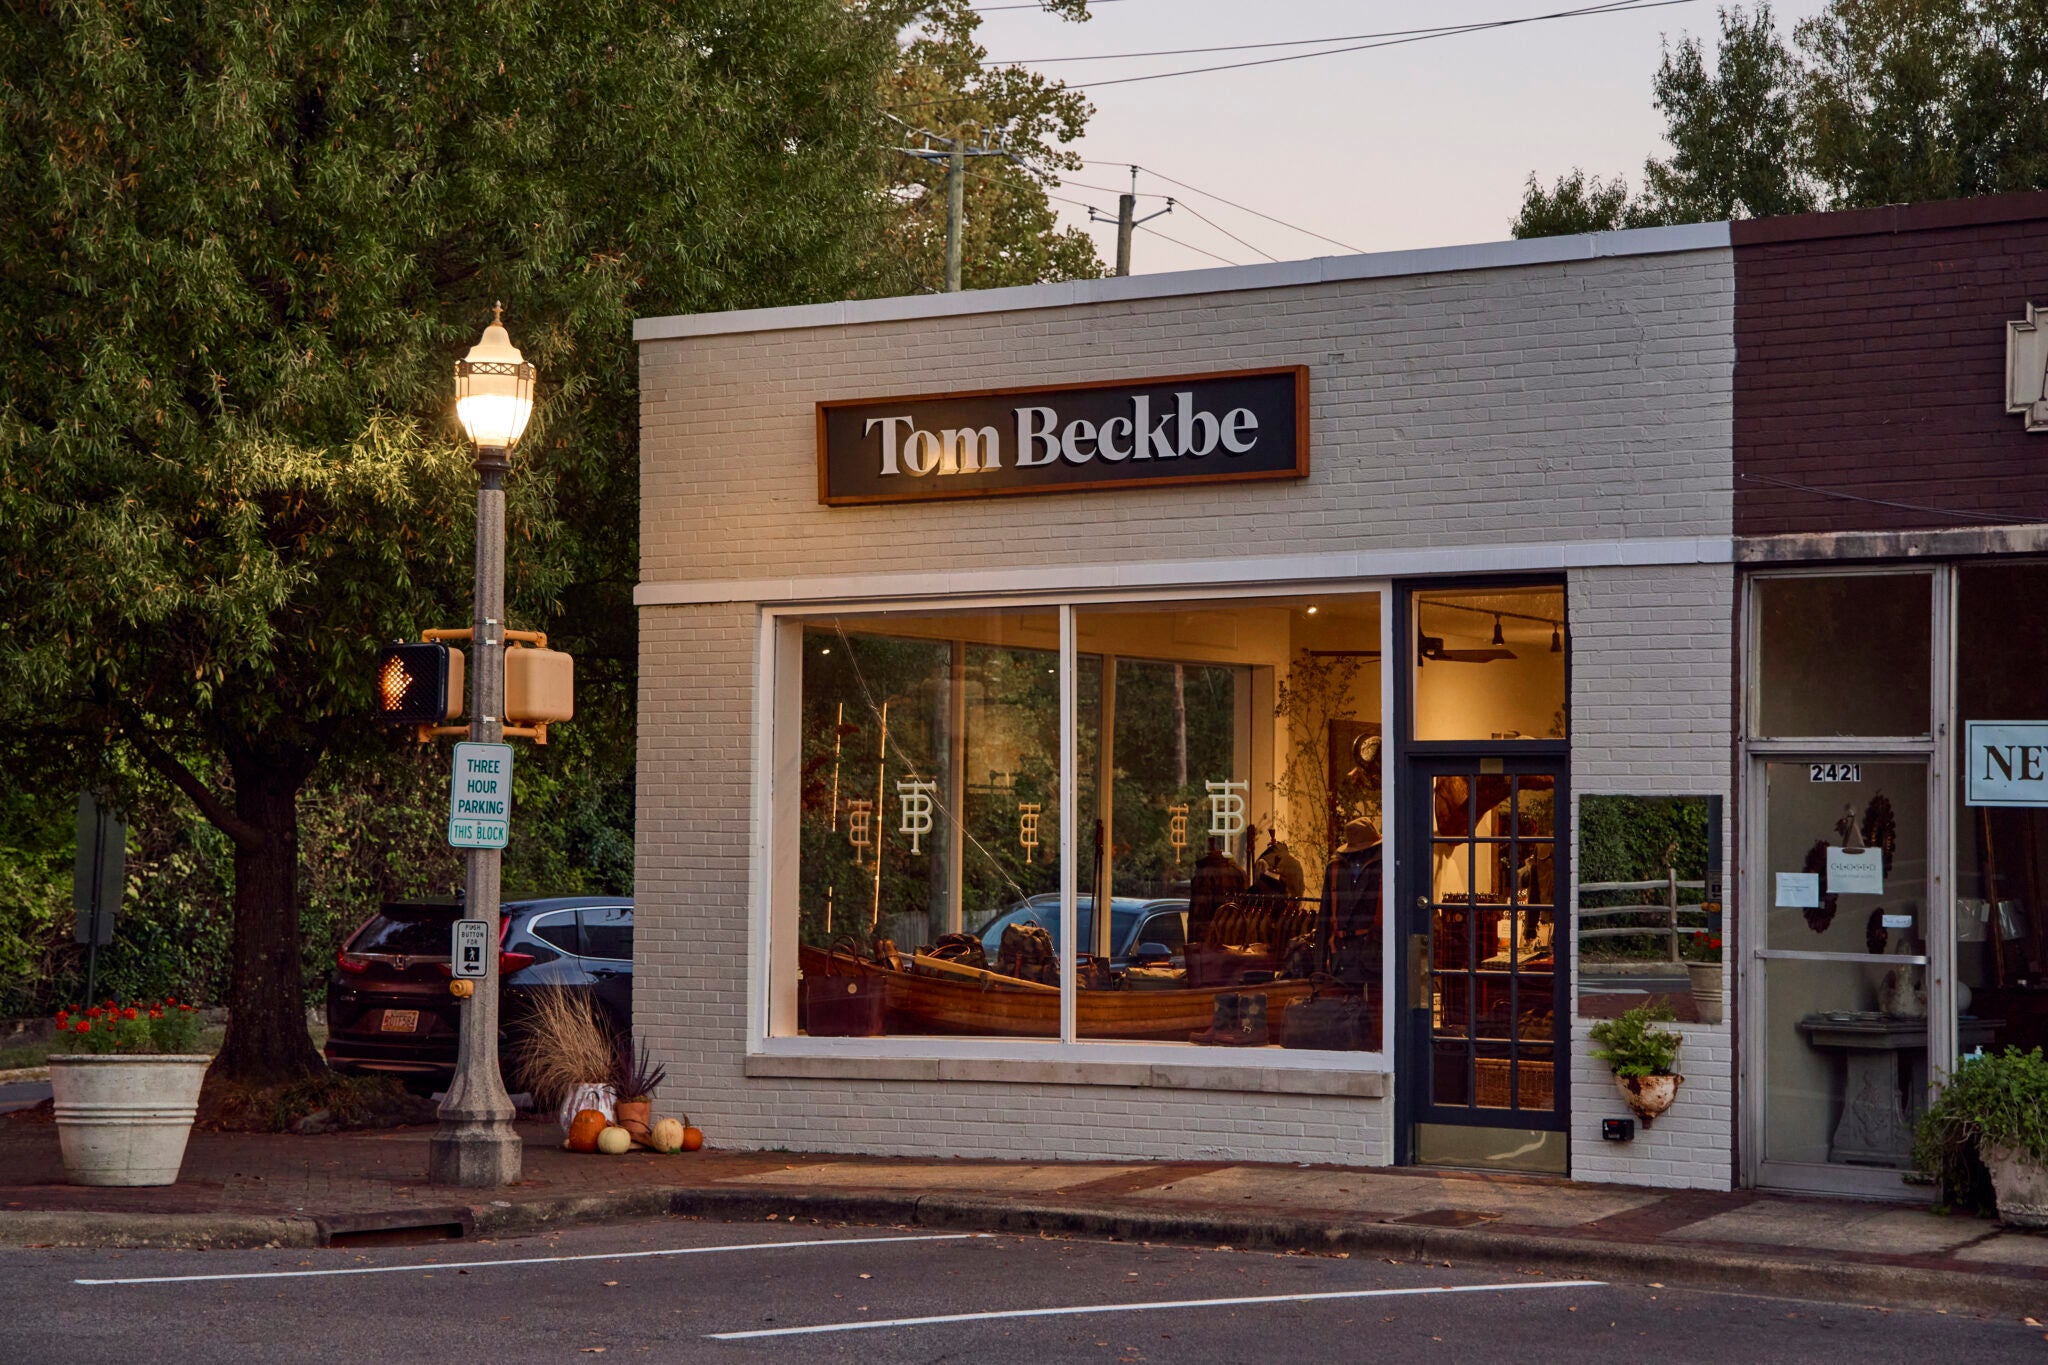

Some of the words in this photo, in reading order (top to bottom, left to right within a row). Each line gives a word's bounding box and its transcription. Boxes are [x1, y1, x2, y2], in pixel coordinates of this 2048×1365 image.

[865, 415, 1002, 477] Tom
[1012, 391, 1259, 468] Beckbe
[467, 759, 500, 774] THREE
[1982, 745, 2048, 781] NE
[1811, 764, 1861, 781] 2421
[467, 780, 497, 794] HOUR
[458, 800, 504, 815] PARKING
[454, 825, 473, 840] THIS
[476, 825, 504, 841] BLOCK
